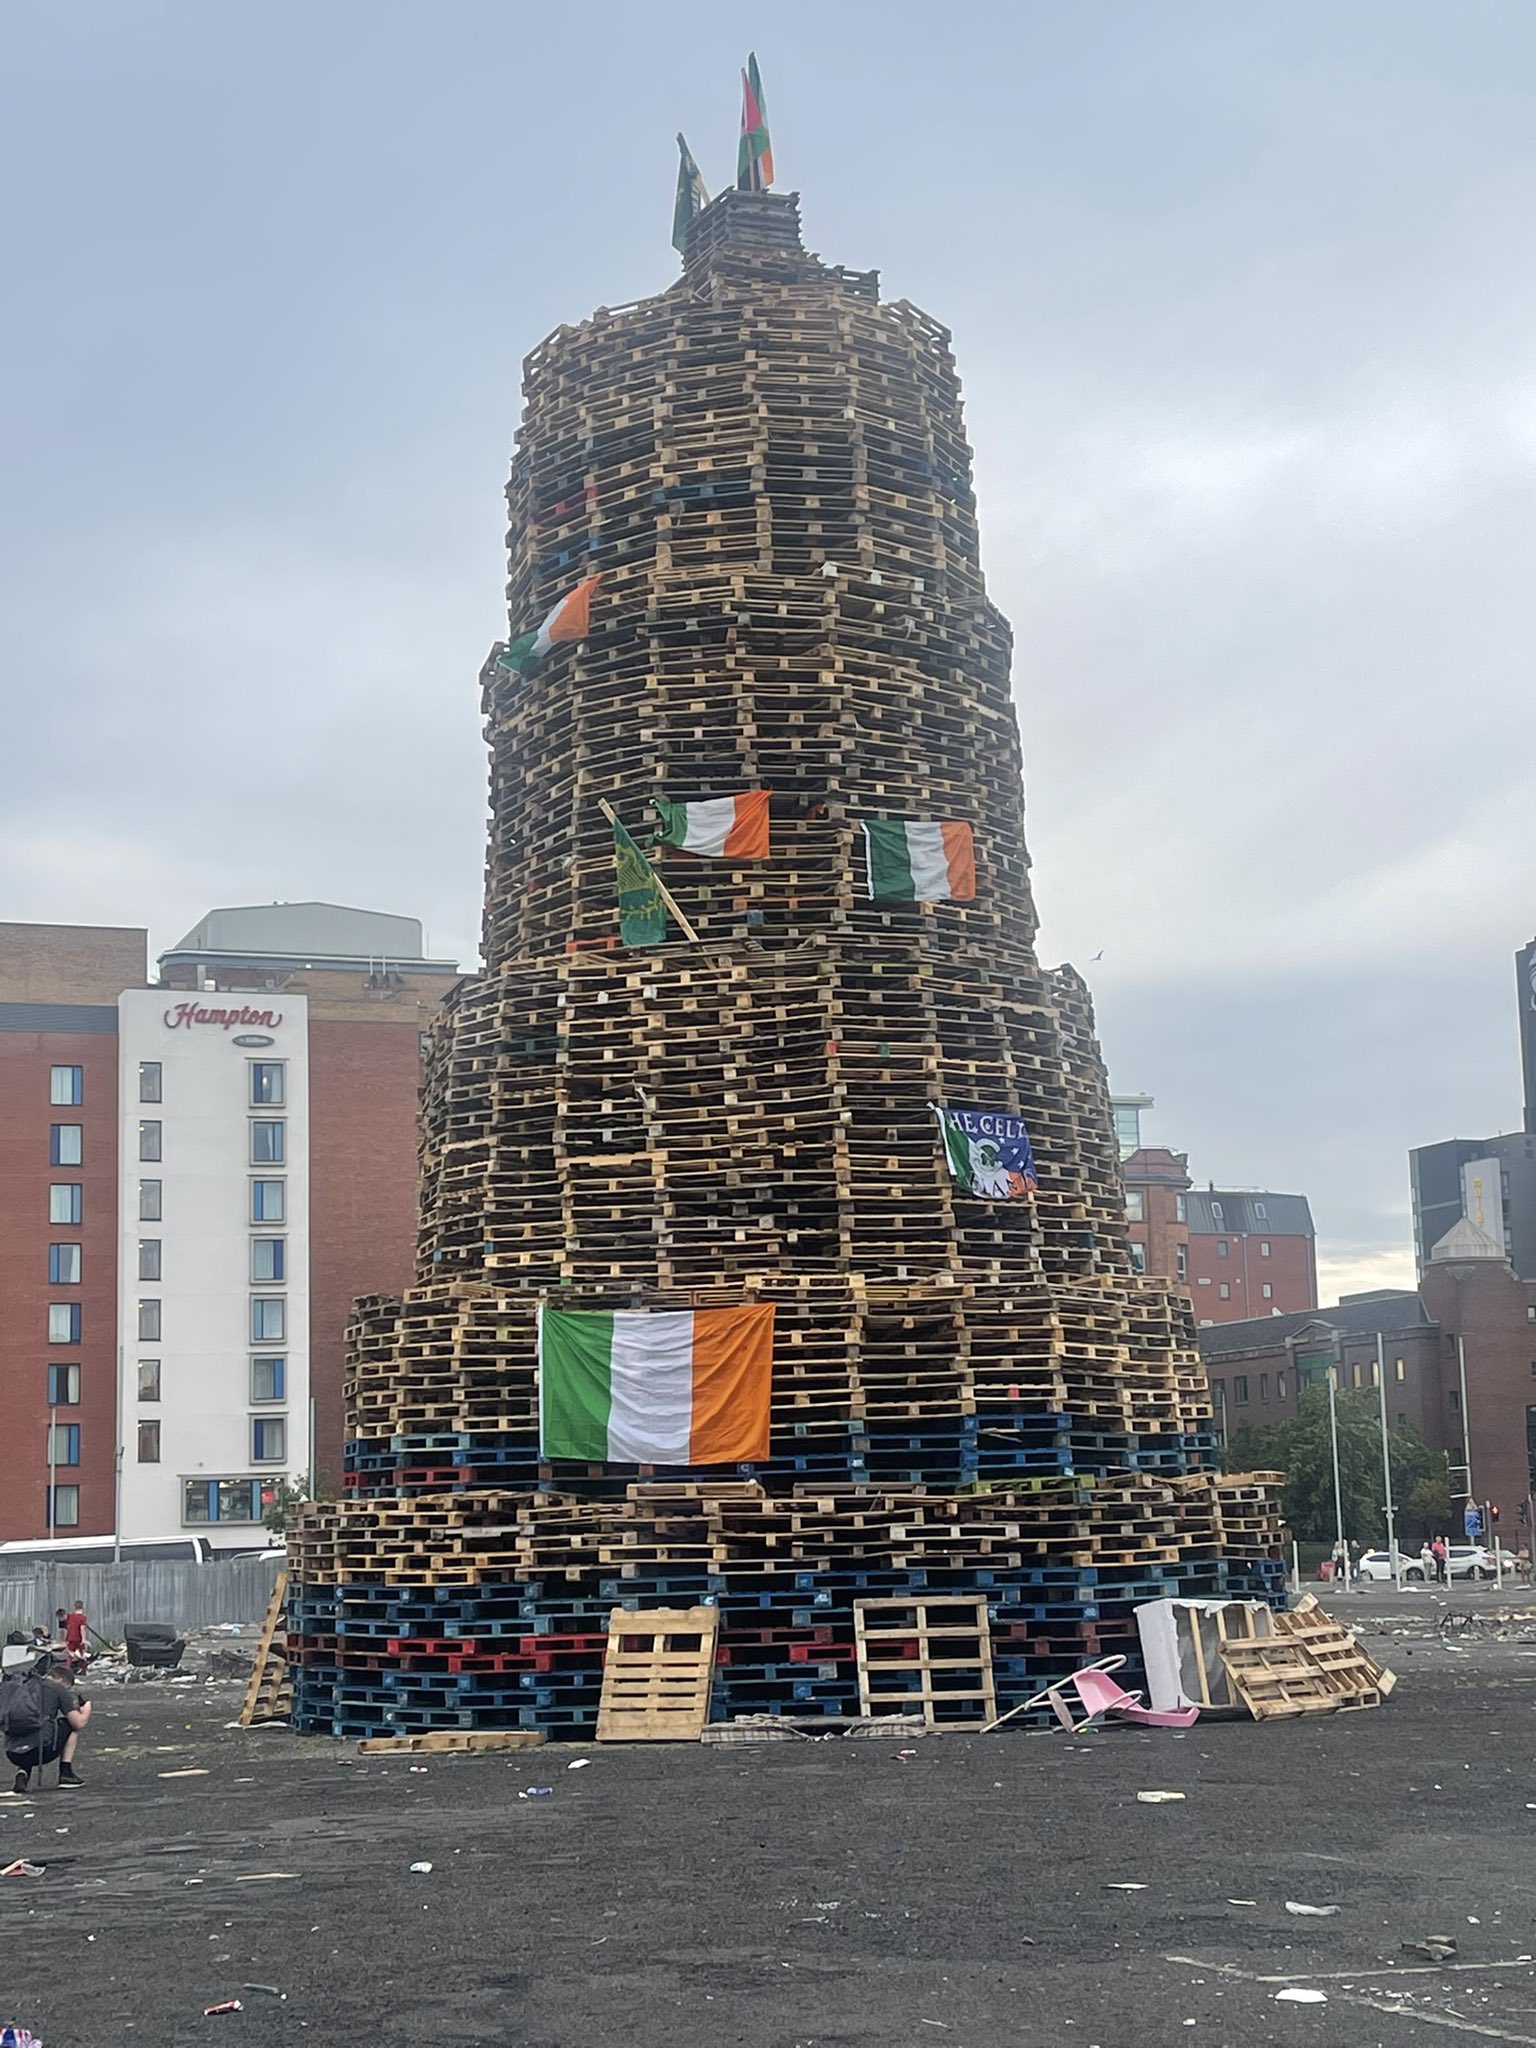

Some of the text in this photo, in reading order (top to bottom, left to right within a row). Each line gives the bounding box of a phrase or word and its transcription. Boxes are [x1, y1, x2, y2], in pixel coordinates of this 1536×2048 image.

[164, 1002, 283, 1031] Hampton
[947, 1112, 1026, 1139] HE CELT
